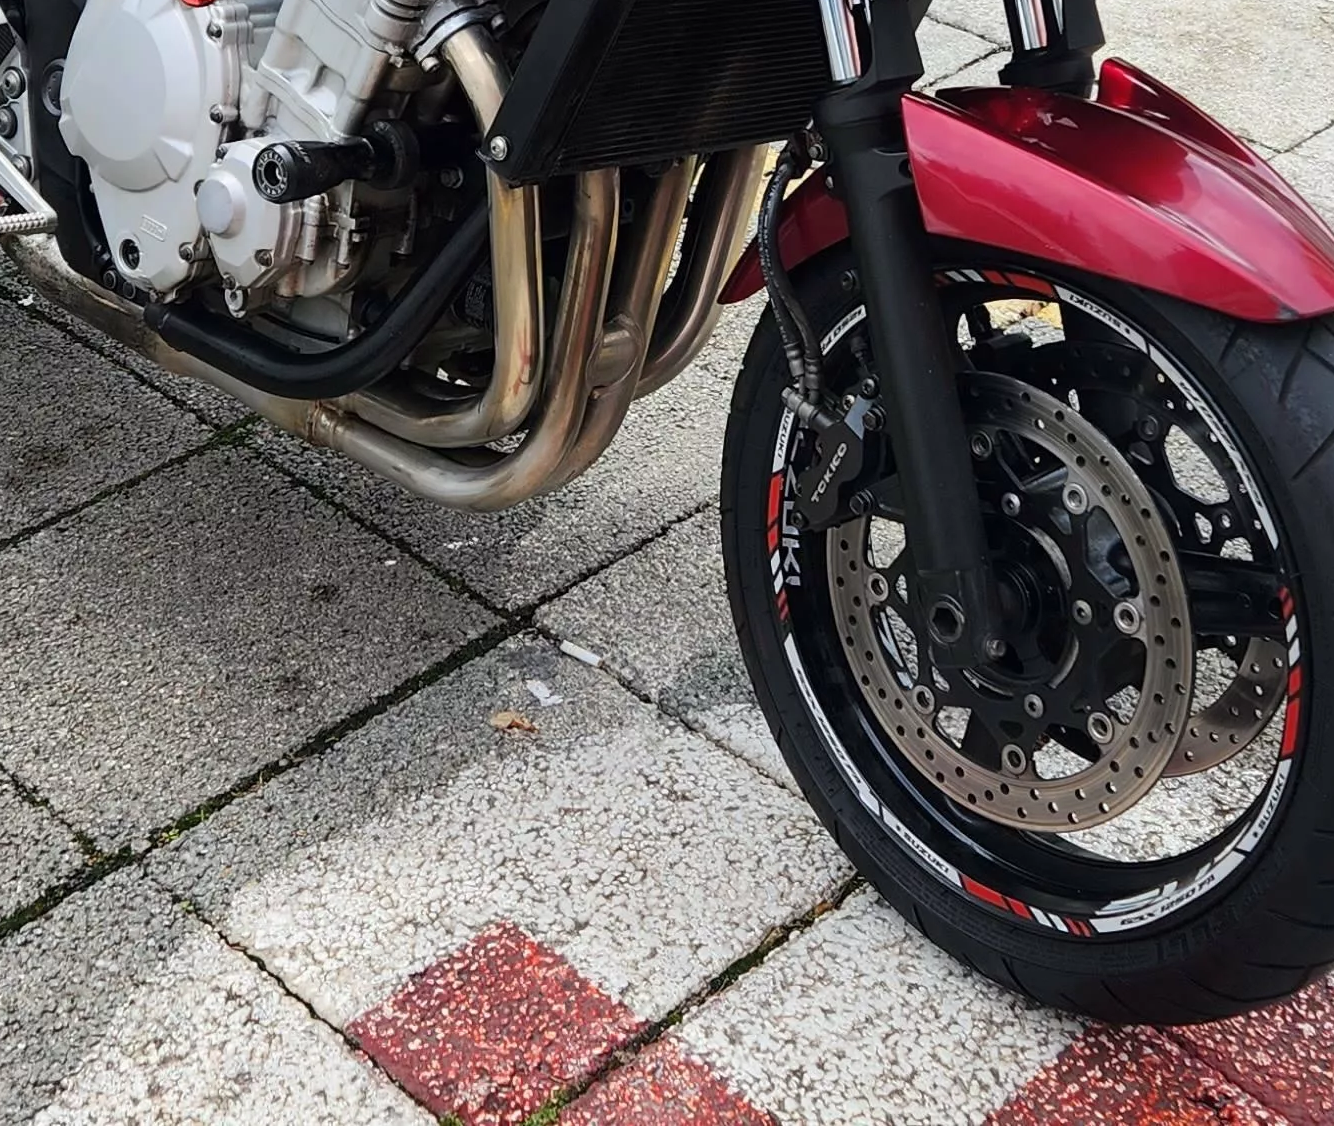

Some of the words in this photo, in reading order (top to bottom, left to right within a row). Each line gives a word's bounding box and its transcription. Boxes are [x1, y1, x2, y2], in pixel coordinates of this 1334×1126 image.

[1069, 293, 1122, 329] SUZUKI
[810, 442, 848, 503] TOKICO
[1258, 773, 1286, 829] SUZUKI
[903, 831, 950, 874] SUZUKI
